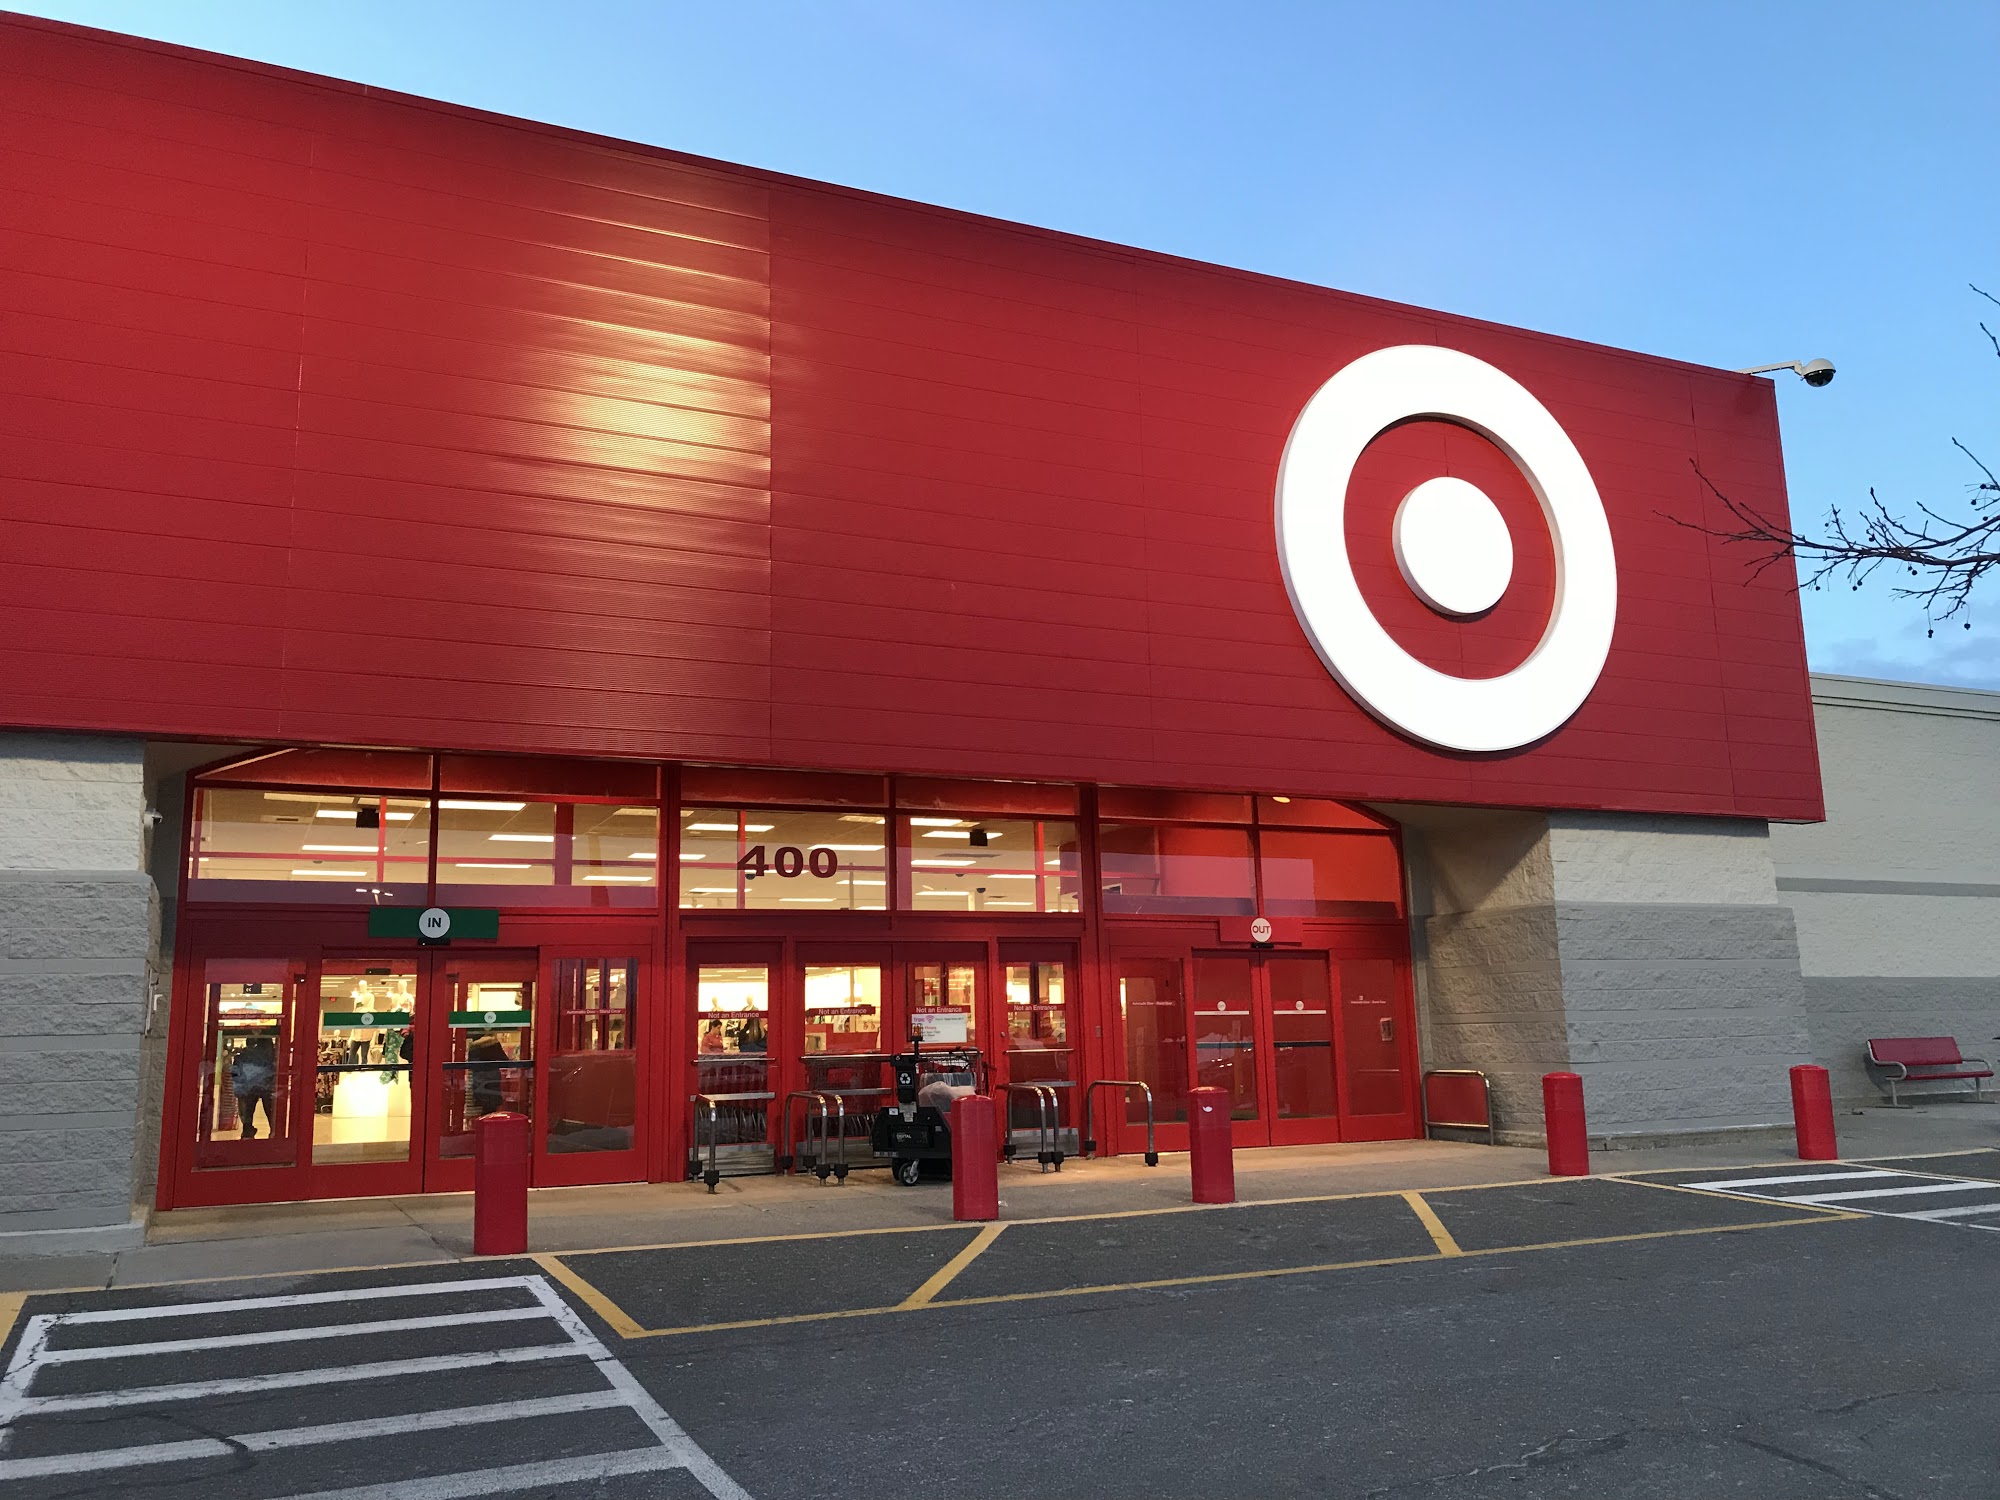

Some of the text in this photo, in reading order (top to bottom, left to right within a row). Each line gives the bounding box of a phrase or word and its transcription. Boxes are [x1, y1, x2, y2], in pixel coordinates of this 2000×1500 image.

[737, 845, 838, 878] 400
[427, 917, 442, 928] IN
[1252, 925, 1270, 934] OUT
